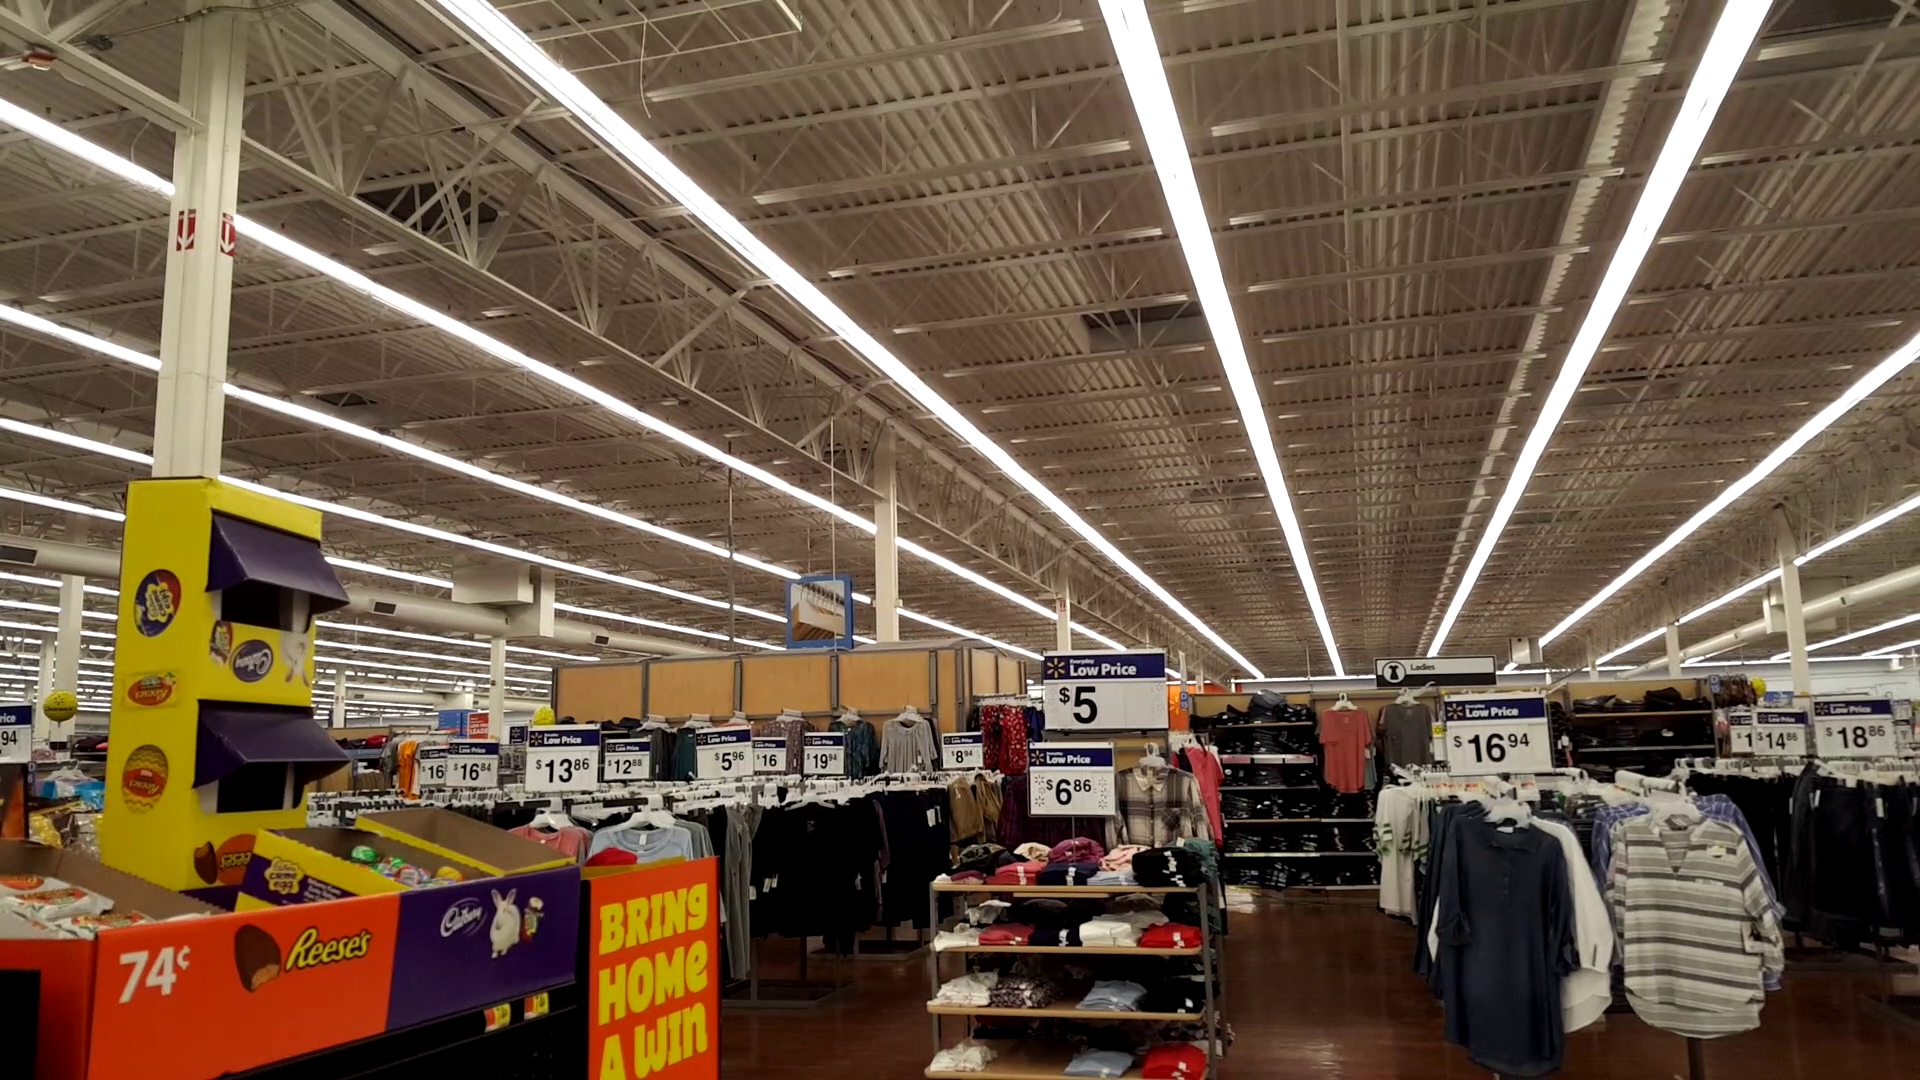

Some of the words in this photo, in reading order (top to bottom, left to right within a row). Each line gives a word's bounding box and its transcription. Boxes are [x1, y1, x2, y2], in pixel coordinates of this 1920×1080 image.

[1069, 664, 1099, 677] Low
[1101, 662, 1137, 676] Price
[1410, 663, 1436, 671] Ladies
[1465, 708, 1489, 718] Low
[1490, 706, 1519, 717] Price
[1830, 705, 1848, 714] Low
[1849, 705, 1871, 713] Price
[0, 712, 16, 723] rice
[543, 735, 561, 745] Low
[561, 735, 582, 744] Price
[1046, 755, 1067, 764] Low
[1066, 754, 1091, 764] Price
[285, 927, 372, 971] Reese's
[600, 1034, 627, 1080] A
